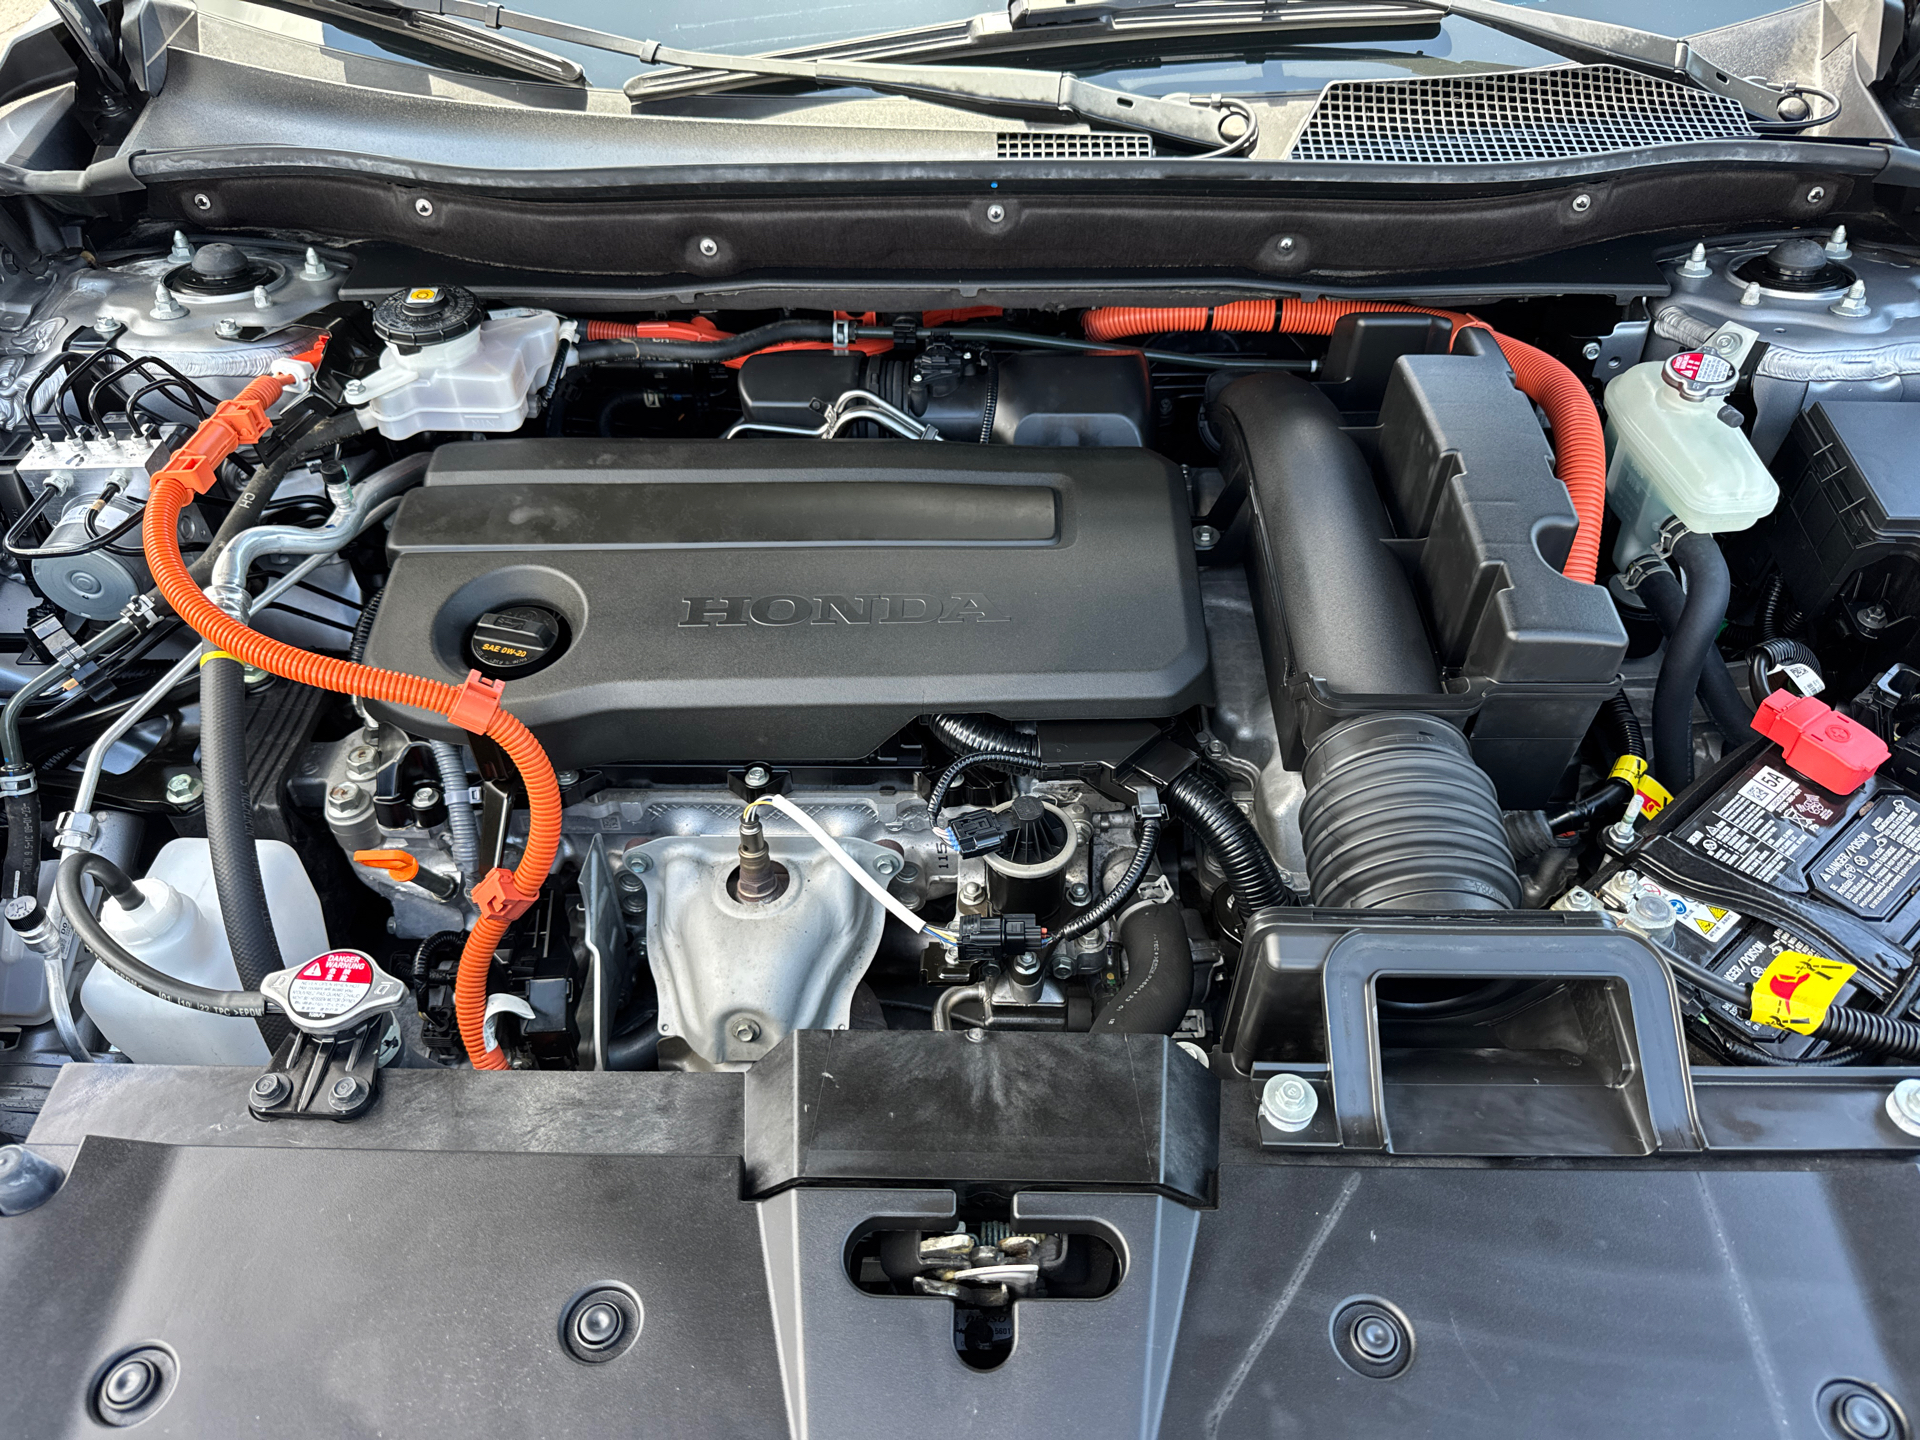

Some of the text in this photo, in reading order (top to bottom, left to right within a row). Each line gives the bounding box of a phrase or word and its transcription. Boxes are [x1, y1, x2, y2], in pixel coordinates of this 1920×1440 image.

[239, 492, 256, 509] CH
[678, 592, 1012, 627] HONDA
[481, 643, 501, 653] SAE
[500, 647, 527, 658] 0W-20
[1761, 772, 1784, 788] 5A
[324, 961, 366, 970] WARNUNG
[328, 954, 361, 963] DANGER
